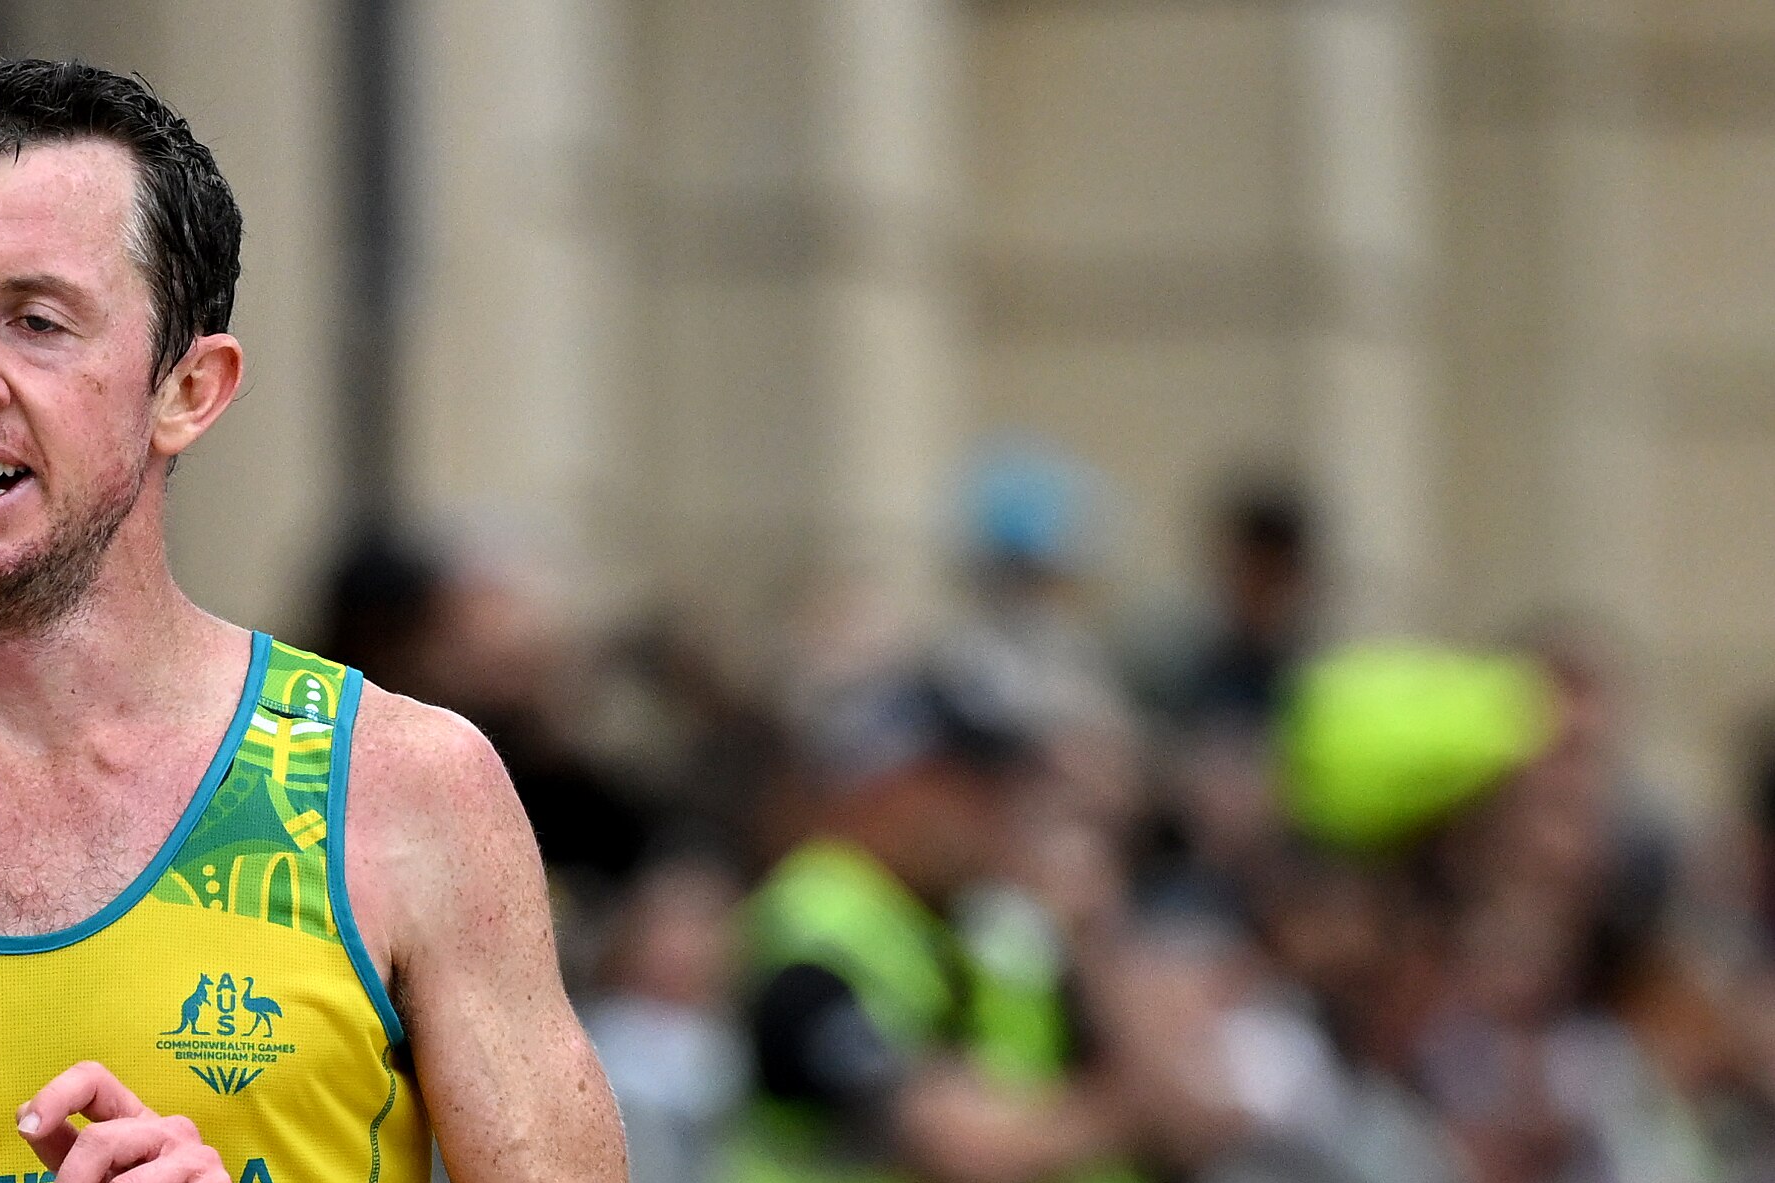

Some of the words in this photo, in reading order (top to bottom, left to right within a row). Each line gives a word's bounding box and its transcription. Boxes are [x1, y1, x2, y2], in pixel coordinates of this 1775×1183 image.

[216, 972, 237, 1036] AUS
[156, 1040, 255, 1051] COMMONWEALTH
[258, 1043, 296, 1054] GAMES
[175, 1051, 248, 1061] BIRMINGHAM
[251, 1053, 278, 1063] 2022
